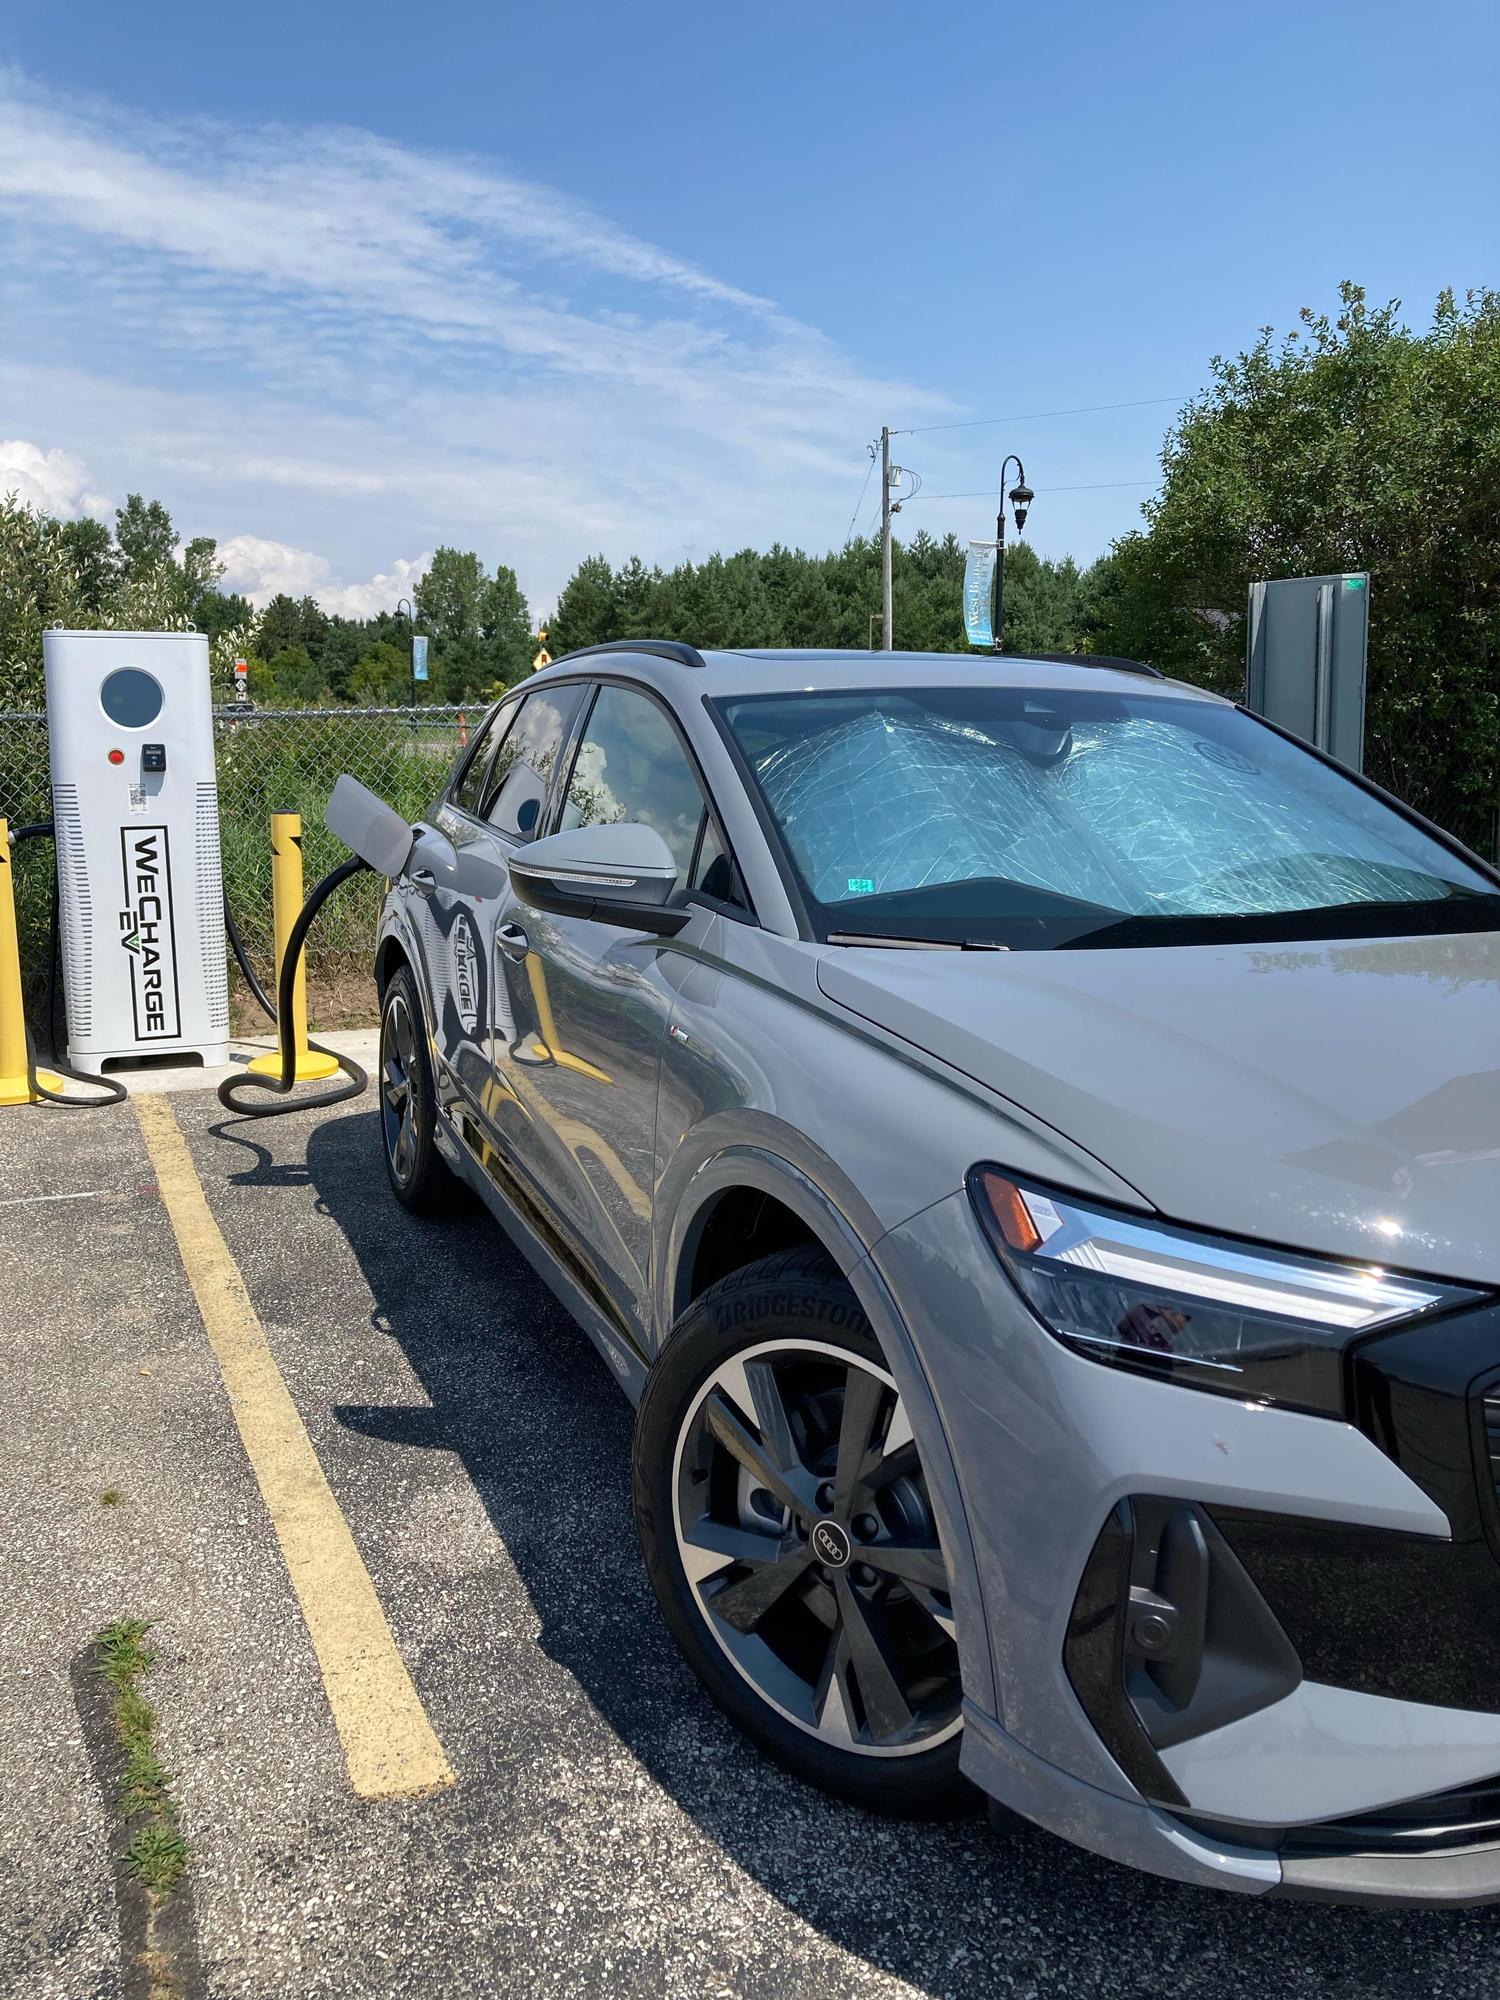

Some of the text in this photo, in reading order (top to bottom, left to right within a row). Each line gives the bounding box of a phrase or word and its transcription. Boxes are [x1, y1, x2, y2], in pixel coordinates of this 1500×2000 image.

[968, 551, 983, 627] West Branch
[119, 911, 141, 955] EV
[134, 835, 165, 1032] WECHARGE
